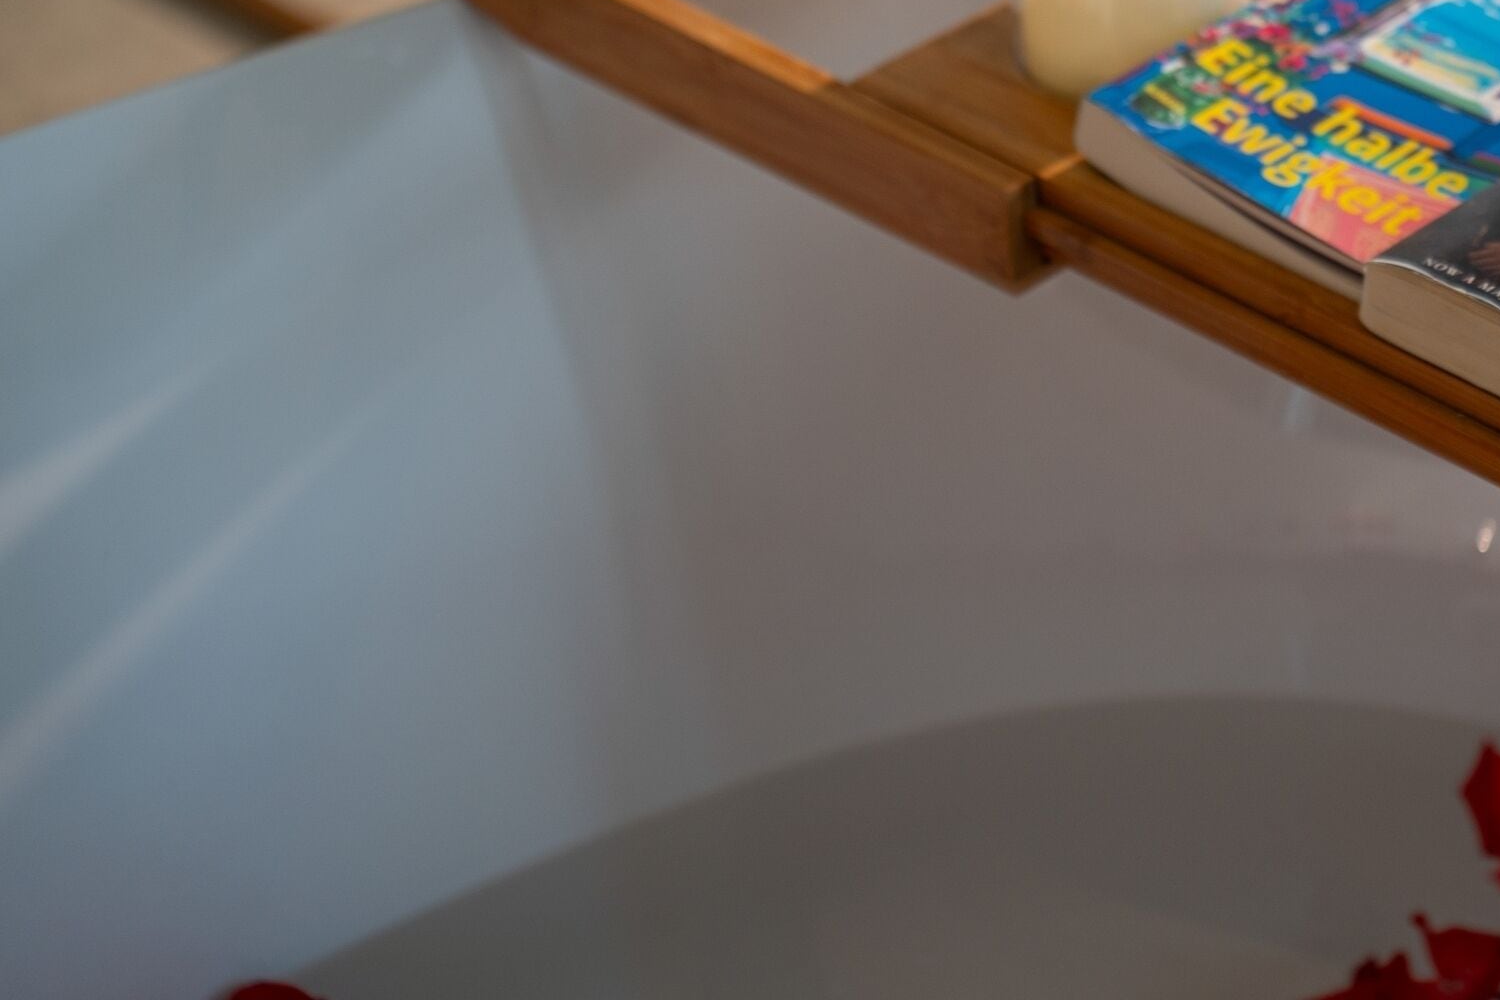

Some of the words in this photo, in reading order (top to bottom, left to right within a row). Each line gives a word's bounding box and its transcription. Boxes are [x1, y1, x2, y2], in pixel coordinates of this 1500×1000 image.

[1191, 96, 1422, 236] Ewigkeit
[1195, 38, 1316, 119] Eine
[1312, 106, 1469, 200] halbe
[1423, 257, 1462, 278] NOW
[1461, 273, 1476, 285] A
